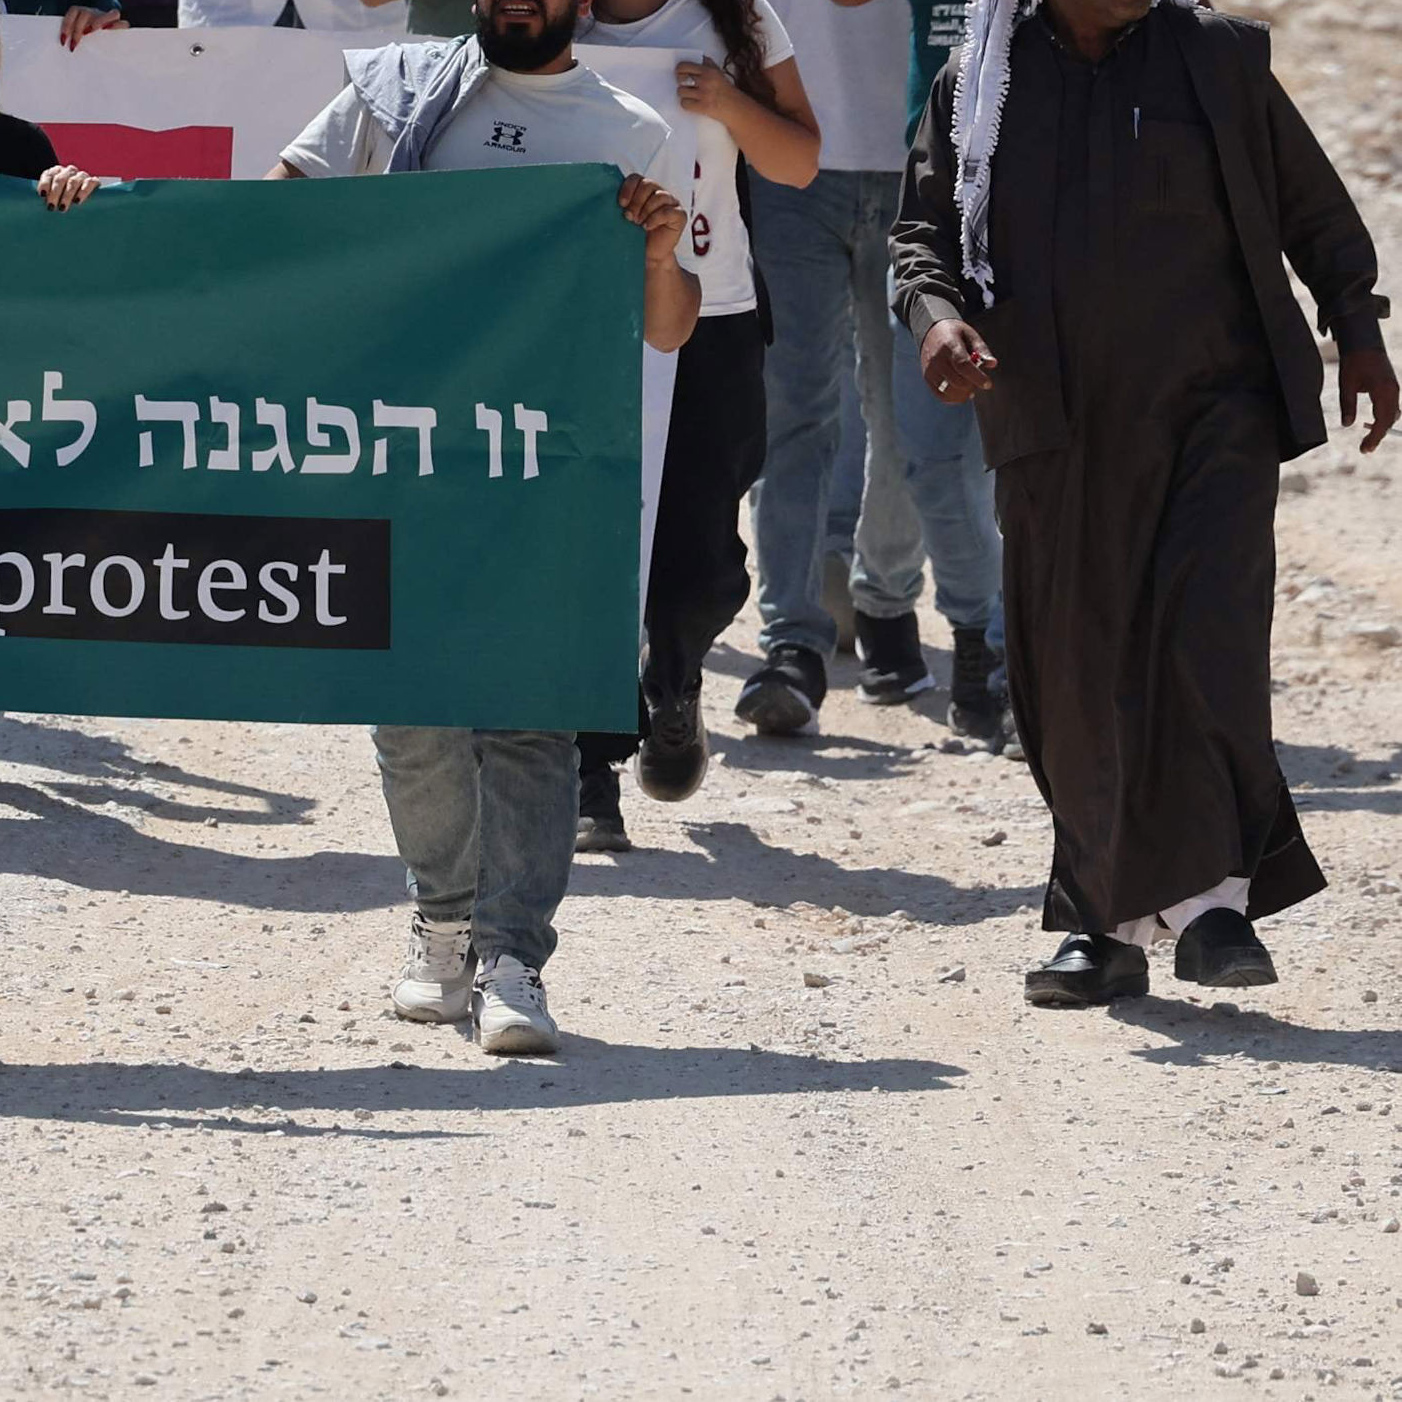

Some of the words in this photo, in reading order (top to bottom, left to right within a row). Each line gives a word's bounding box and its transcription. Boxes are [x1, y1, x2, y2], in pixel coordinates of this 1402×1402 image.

[483, 141, 526, 153] ARMOUR
[494, 120, 527, 131] UNDER
[134, 394, 437, 477] הפגנה
[475, 401, 547, 480] זו
